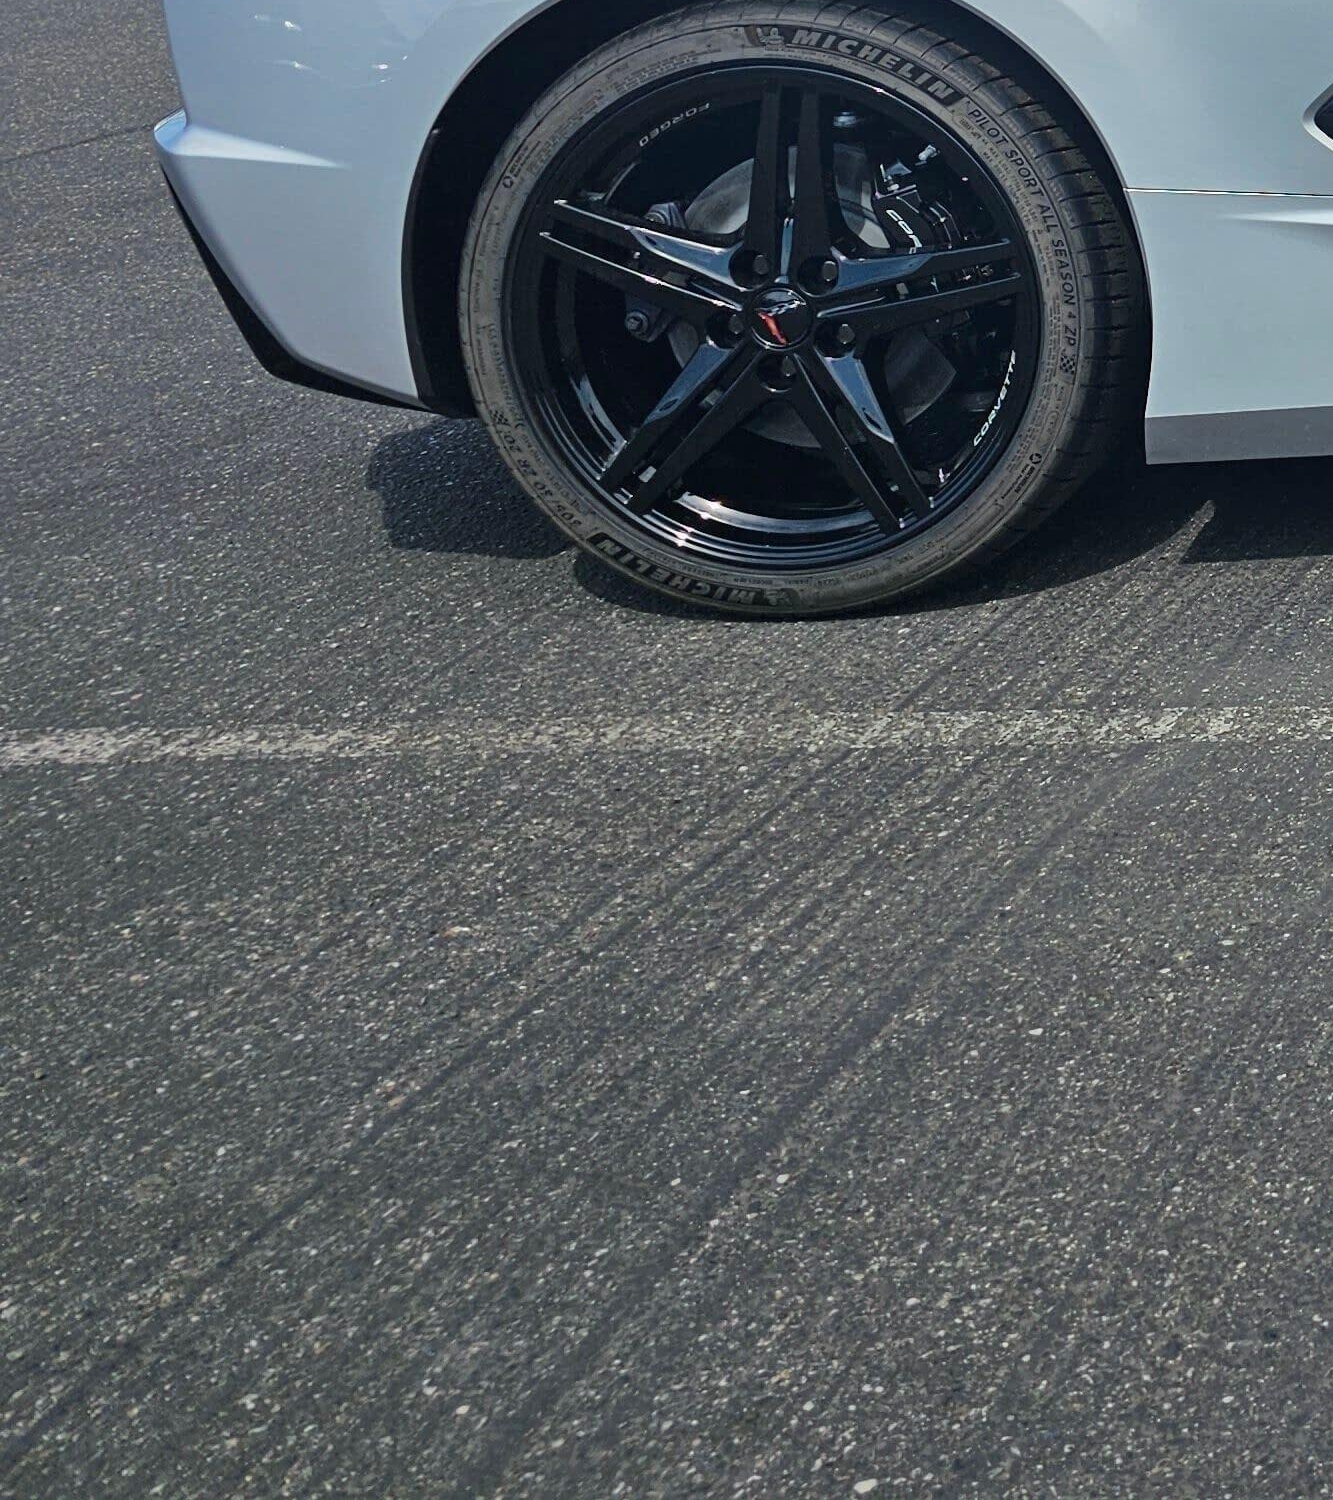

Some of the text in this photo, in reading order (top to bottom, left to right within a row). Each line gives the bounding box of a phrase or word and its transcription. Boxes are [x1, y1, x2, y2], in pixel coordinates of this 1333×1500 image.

[791, 29, 954, 99] MICHELIN
[639, 103, 710, 147] FORGED
[967, 109, 1009, 145] PILOT
[1005, 149, 1045, 197] SPORT
[1036, 204, 1059, 233] ALL
[1052, 239, 1076, 306] SEASON
[1064, 325, 1077, 346] ZP
[973, 349, 1016, 447] CORVETTE
[600, 538, 756, 606] MICHELIN
